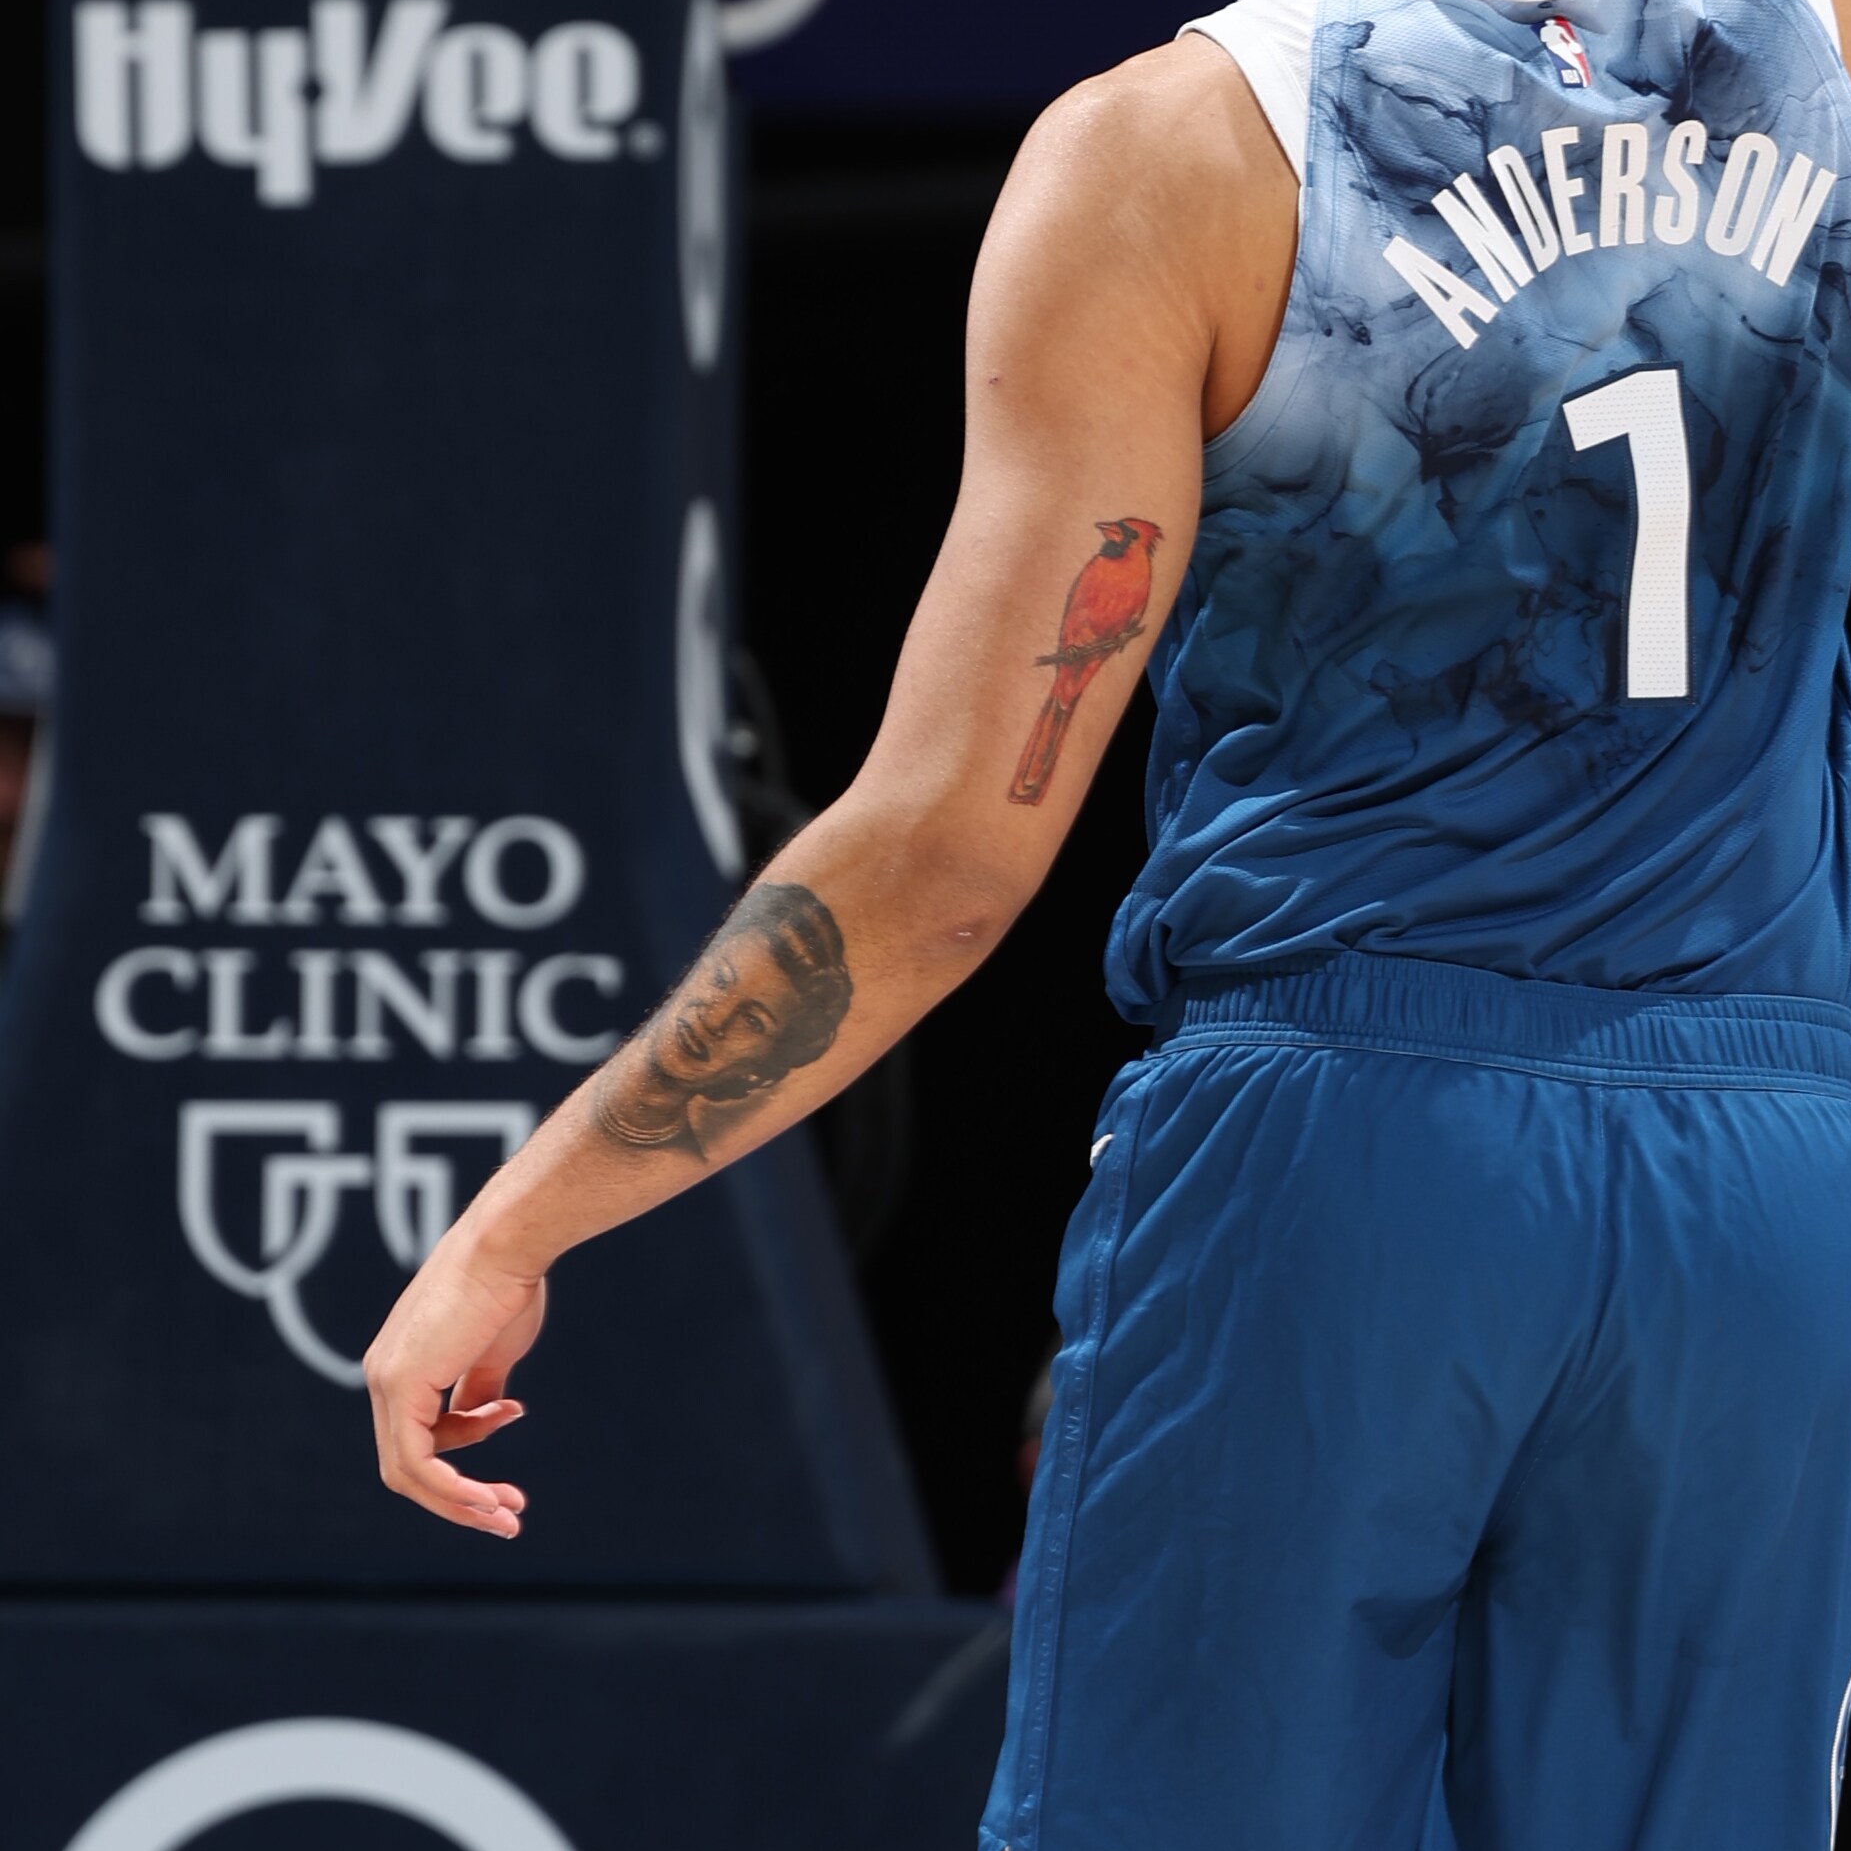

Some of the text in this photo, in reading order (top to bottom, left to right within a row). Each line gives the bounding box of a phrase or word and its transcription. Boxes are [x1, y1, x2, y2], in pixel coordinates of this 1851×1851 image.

[1386, 120, 1837, 350] ANDERSON
[1563, 370, 1691, 698] 1
[143, 816, 585, 927] MAYO
[96, 949, 622, 1061] CLINIC
